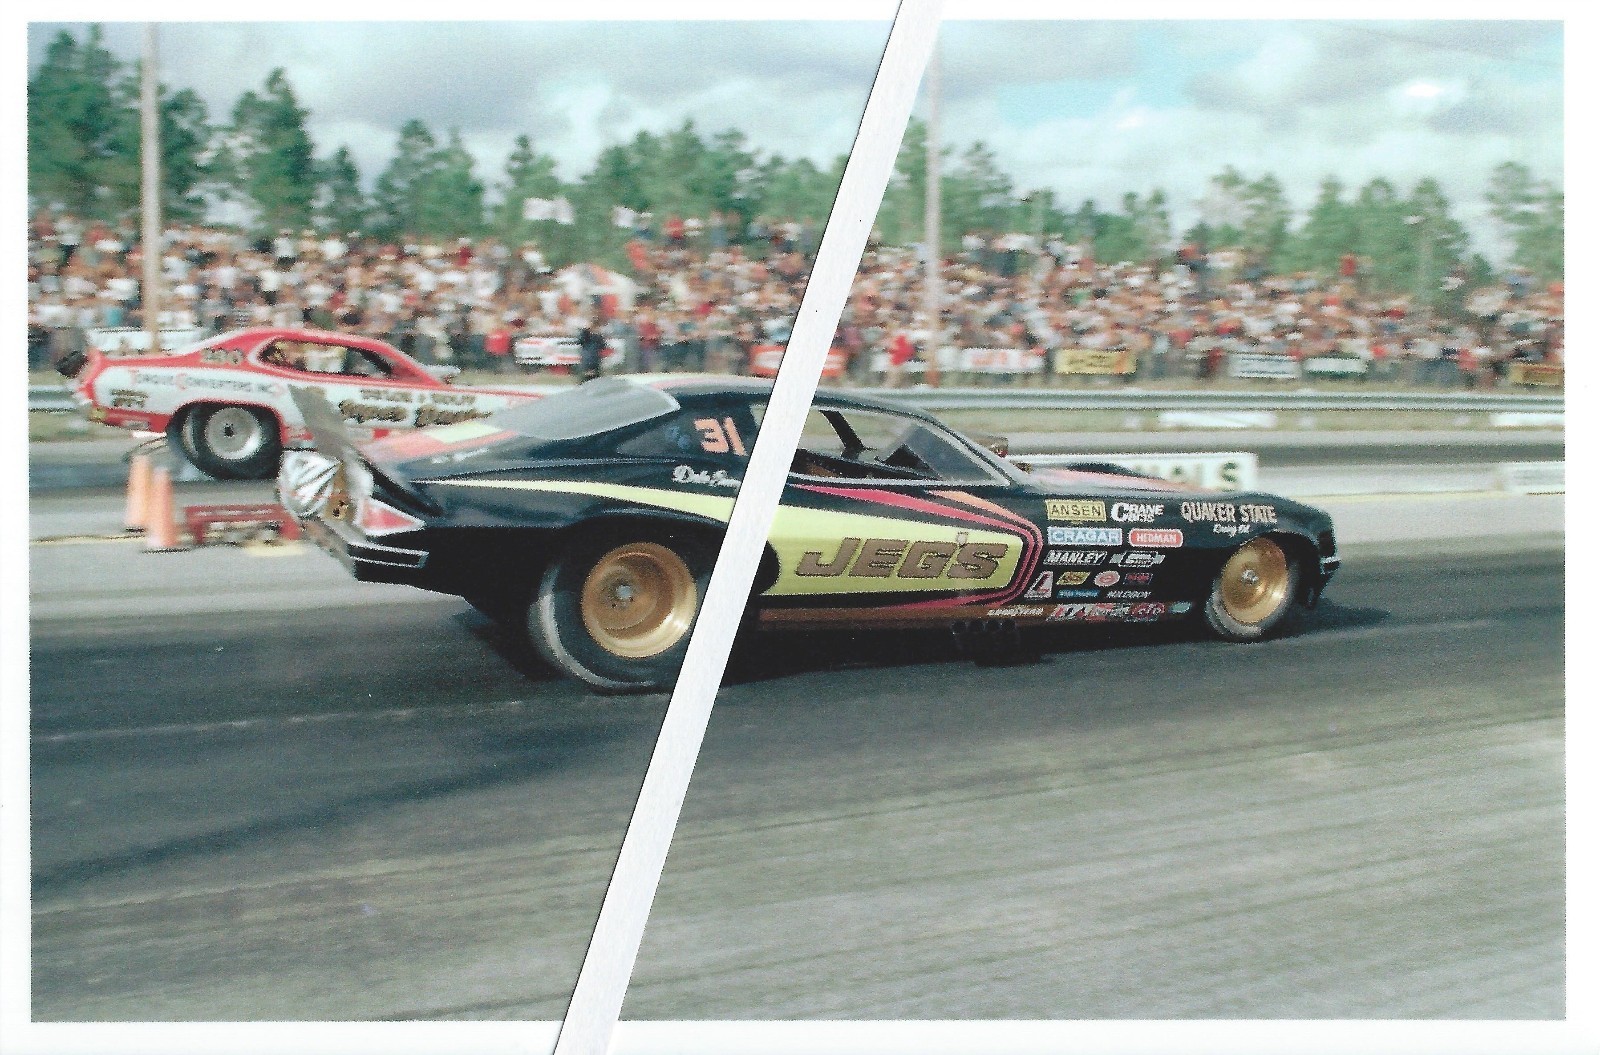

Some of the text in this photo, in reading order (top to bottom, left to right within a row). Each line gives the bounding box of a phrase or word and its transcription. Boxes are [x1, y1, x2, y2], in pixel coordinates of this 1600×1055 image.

[694, 416, 748, 457] 31
[1051, 504, 1101, 517] ANSEN
[1110, 502, 1165, 522] CRANE
[1180, 501, 1278, 524] QUAKER STATE
[1051, 530, 1119, 543] CRAGAR
[1135, 532, 1177, 543] HEDMAN
[1046, 551, 1103, 564] MANLEY
